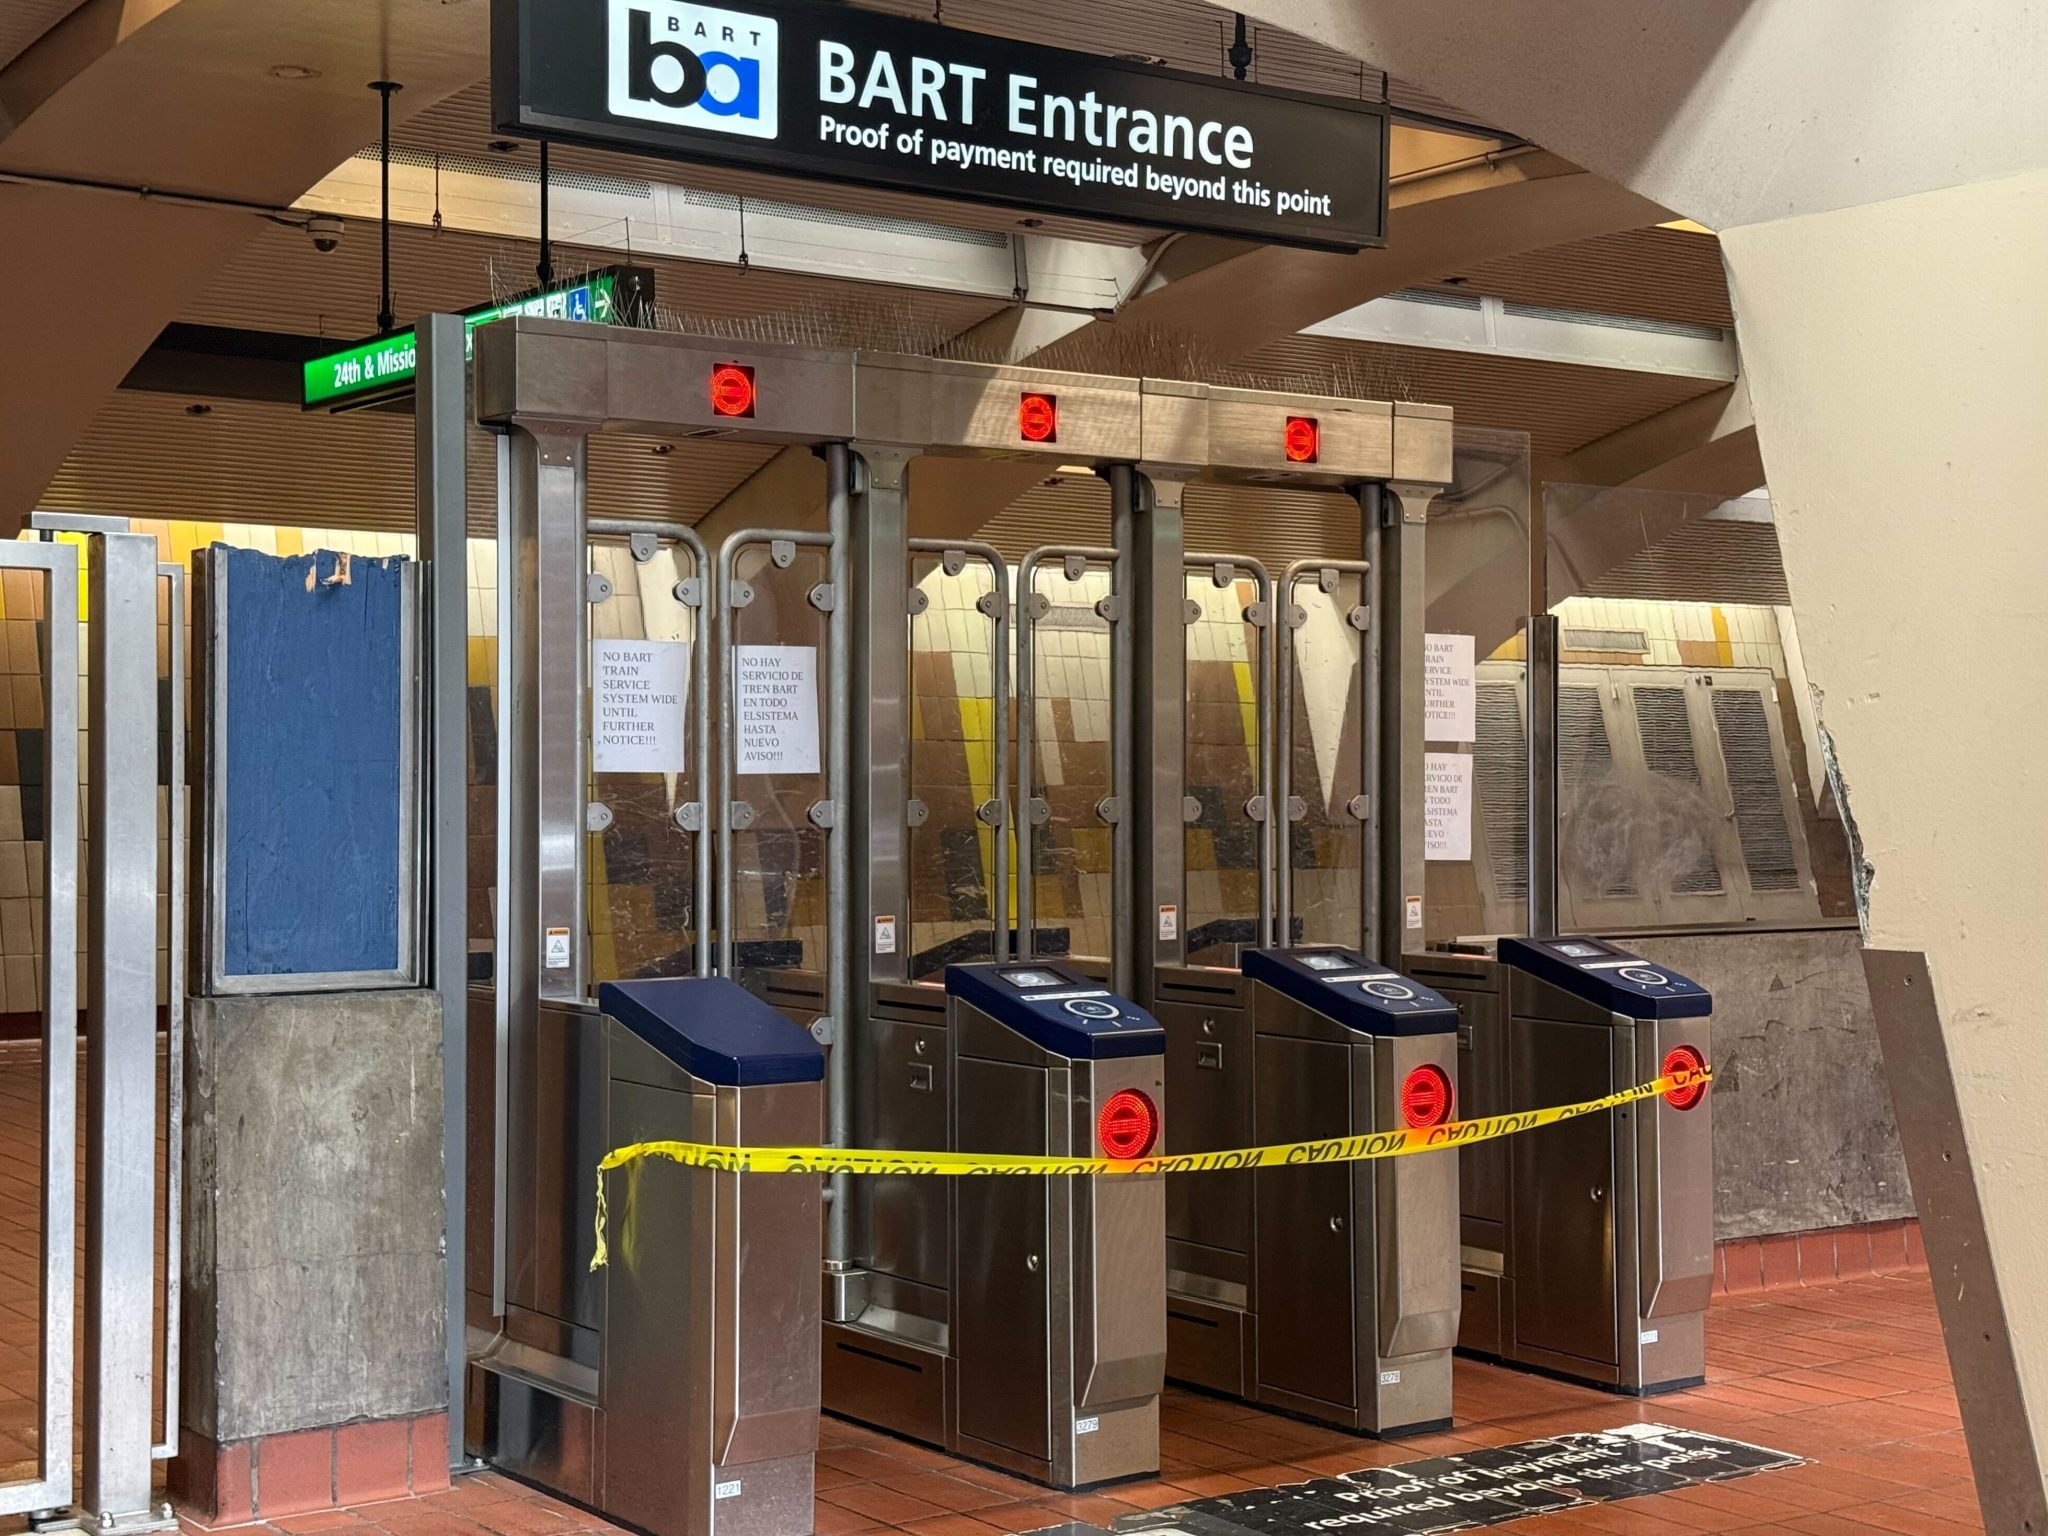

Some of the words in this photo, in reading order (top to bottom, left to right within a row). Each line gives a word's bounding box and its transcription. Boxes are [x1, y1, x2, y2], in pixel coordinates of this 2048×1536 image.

[667, 16, 761, 47] BART
[819, 39, 987, 126] BART
[1009, 73, 1254, 169] Entrance
[820, 115, 890, 150] Proof
[896, 129, 924, 156] of
[931, 138, 1037, 173] payment
[1043, 155, 1139, 188] required
[1146, 164, 1226, 201] beyond
[1232, 178, 1271, 208] this
[1276, 189, 1332, 217] point
[333, 357, 361, 388] 24th
[364, 354, 375, 380] &
[377, 343, 417, 377] Missio
[1434, 644, 1454, 653] BART
[603, 652, 620, 662] NO
[623, 652, 654, 662] BART
[742, 657, 758, 667] NO
[760, 657, 781, 667] HAY
[1425, 655, 1445, 663] RAIN
[603, 665, 639, 676] TRAIN
[1425, 666, 1452, 675] ERVICE
[742, 671, 789, 681] SERVICIO
[791, 671, 804, 681] DE
[603, 679, 651, 690] SERVICE
[1425, 677, 1451, 686] YSTEM
[1452, 678, 1470, 687] WIDE
[743, 684, 770, 694] TREN
[772, 684, 799, 694] BART
[1425, 688, 1444, 697] NTIL
[603, 693, 649, 704] SYSTEM
[651, 694, 678, 705] WIDE
[744, 698, 757, 708] EN
[759, 698, 788, 708] TODO
[1425, 700, 1455, 709] URTHER
[603, 707, 638, 718] UNTIL
[744, 711, 799, 721] ELSISTEMA
[1425, 711, 1456, 720] OTICE!!!
[603, 721, 655, 732] FURTHER
[744, 724, 776, 735] HASTA
[603, 735, 656, 746] NOTICE!!!
[744, 738, 780, 748] NUEVO
[744, 751, 783, 761] AVISO!!!
[1431, 763, 1447, 771] HAY
[1425, 774, 1452, 783] RVICIO
[1453, 775, 1463, 783] DE
[1440, 785, 1458, 794] BART
[1430, 796, 1451, 805] TODO
[1425, 807, 1458, 816] SISTEMA
[717, 1483, 740, 1496] 1221
[1333, 1479, 1435, 1503] Proof
[1438, 1469, 1478, 1486] of
[1303, 1496, 1456, 1530] required
[1445, 1473, 1582, 1502] beyond
[1579, 1463, 1644, 1479] this
